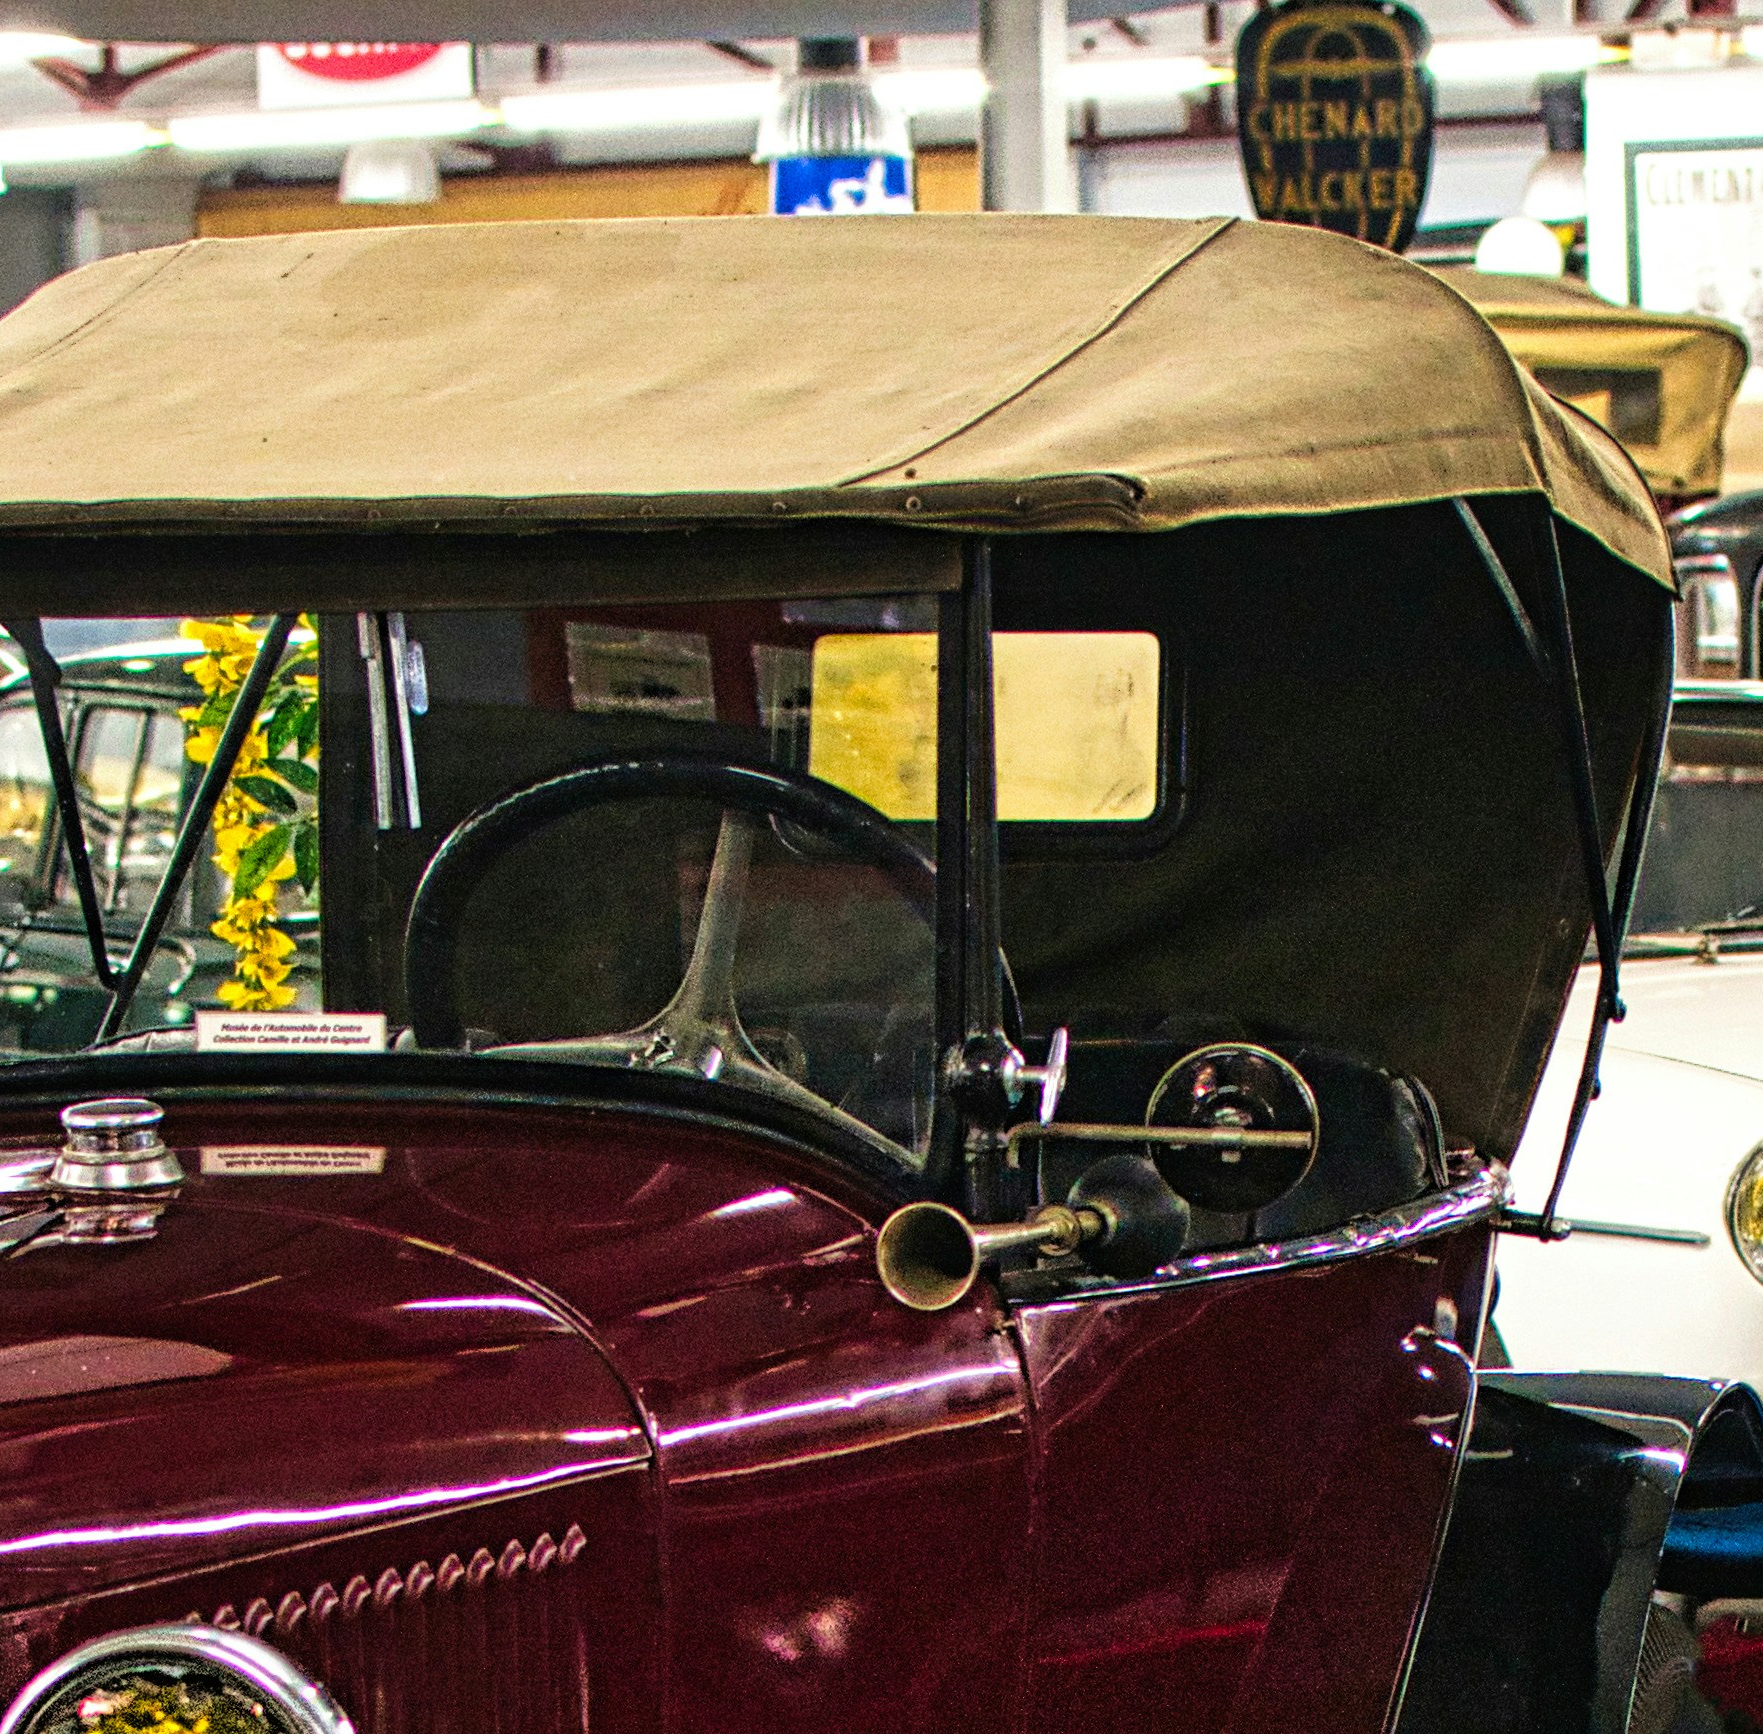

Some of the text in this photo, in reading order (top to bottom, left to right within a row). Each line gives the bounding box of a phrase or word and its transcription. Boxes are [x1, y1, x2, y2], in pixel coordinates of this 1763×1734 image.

[1246, 99, 1426, 140] CHENARD
[1253, 168, 1418, 211] WALCKER
[213, 1035, 255, 1044] Collection
[257, 1035, 290, 1044] Camille
[291, 1035, 301, 1044] et
[303, 1035, 329, 1044] André
[220, 1023, 363, 1033] Musée de l'Automobile du Centre
